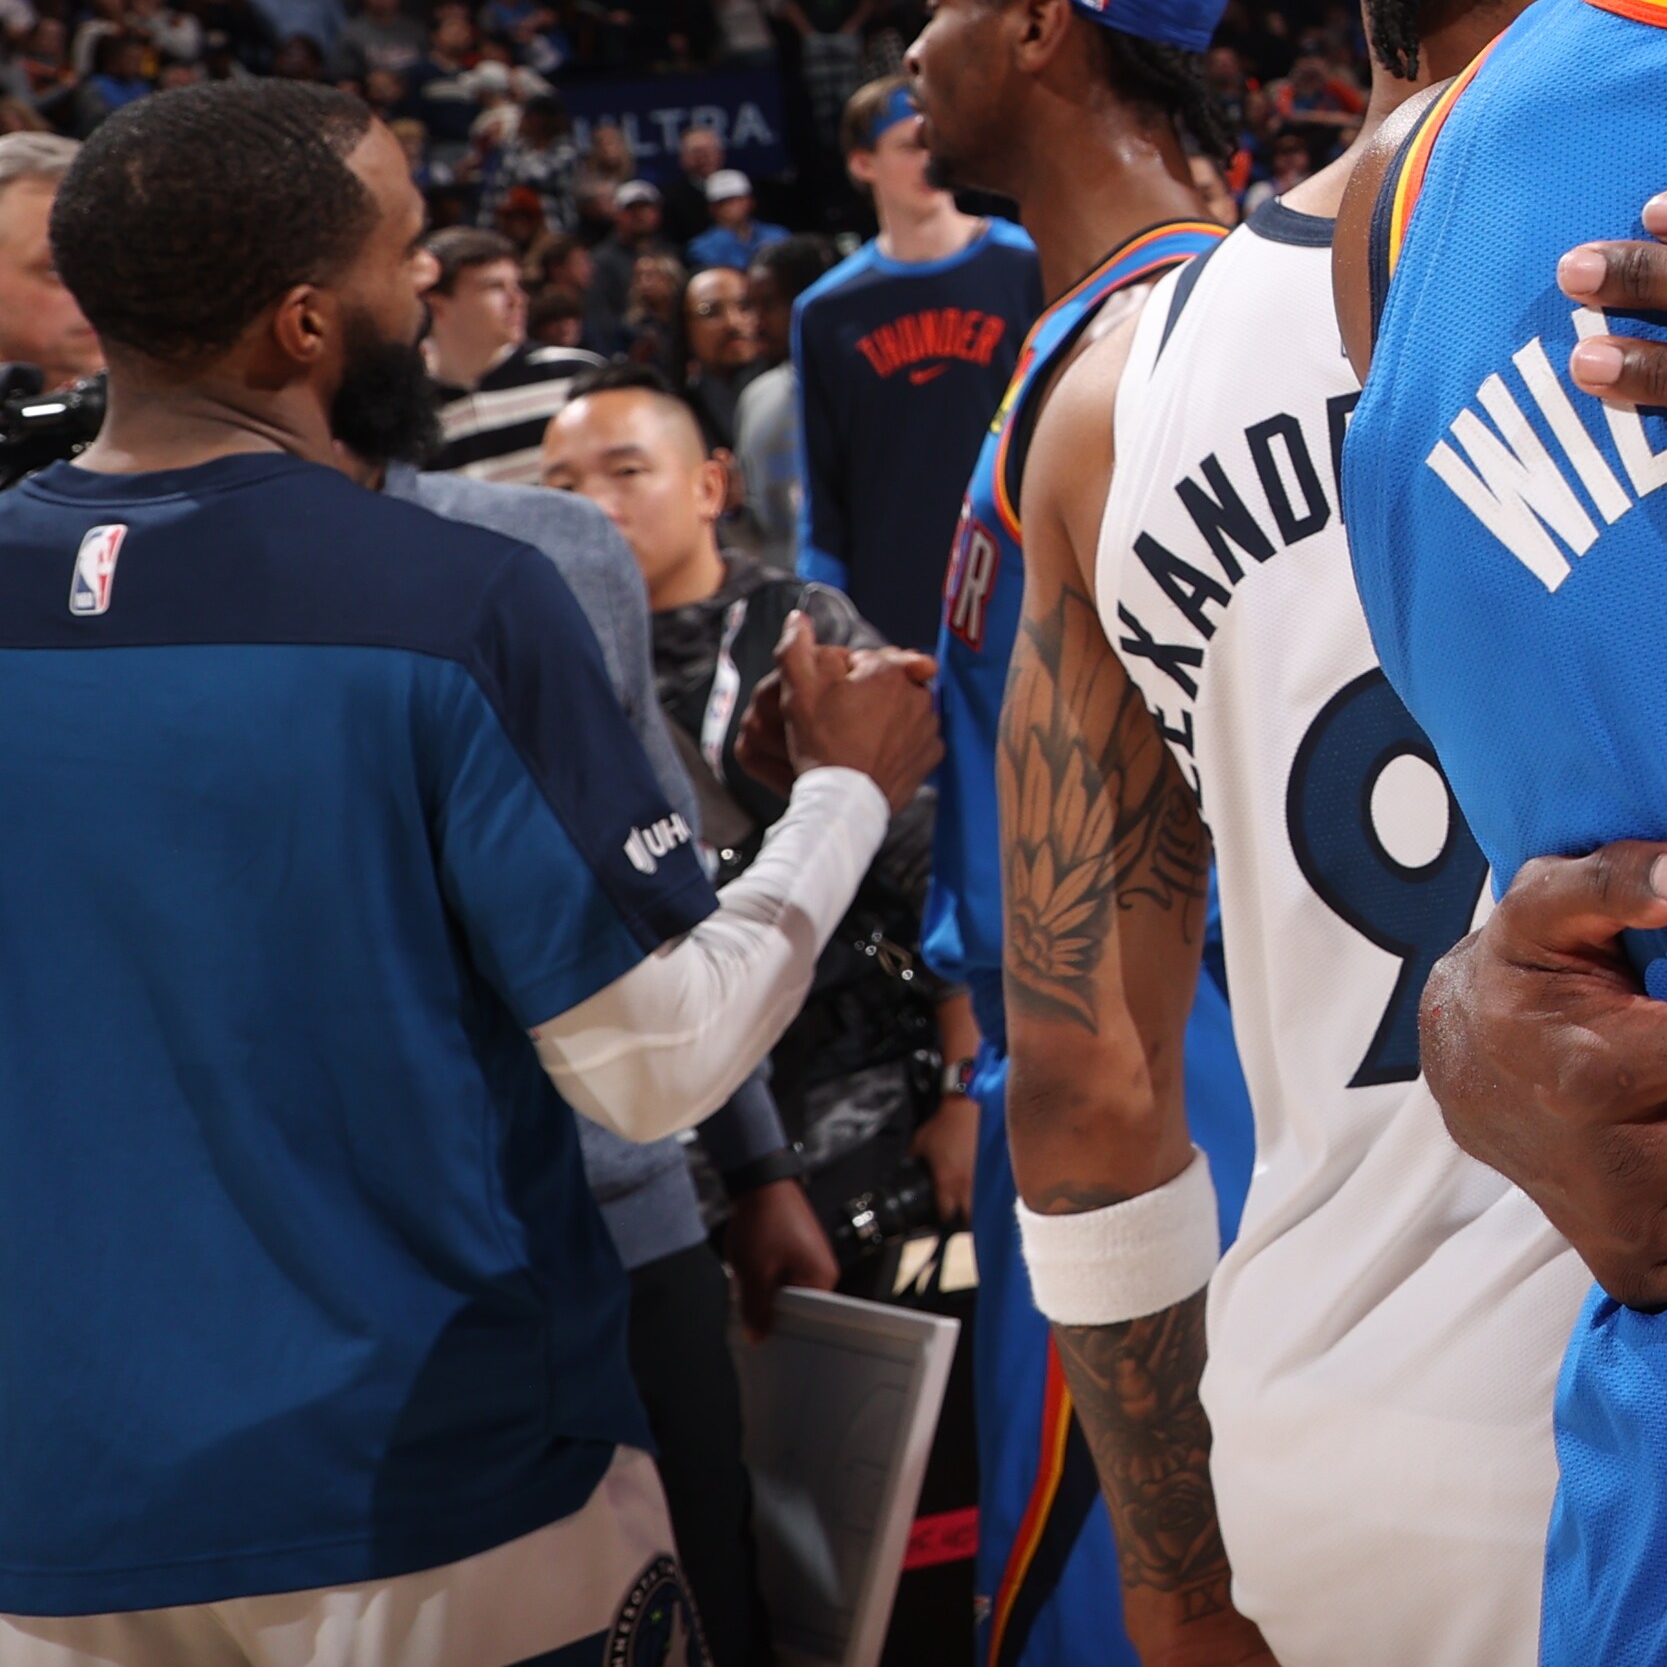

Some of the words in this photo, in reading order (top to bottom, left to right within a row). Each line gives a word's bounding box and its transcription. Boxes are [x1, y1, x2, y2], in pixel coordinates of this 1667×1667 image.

[854, 305, 1007, 379] THUNDER
[640, 812, 694, 858] UH
[1286, 665, 1491, 1088] 9
